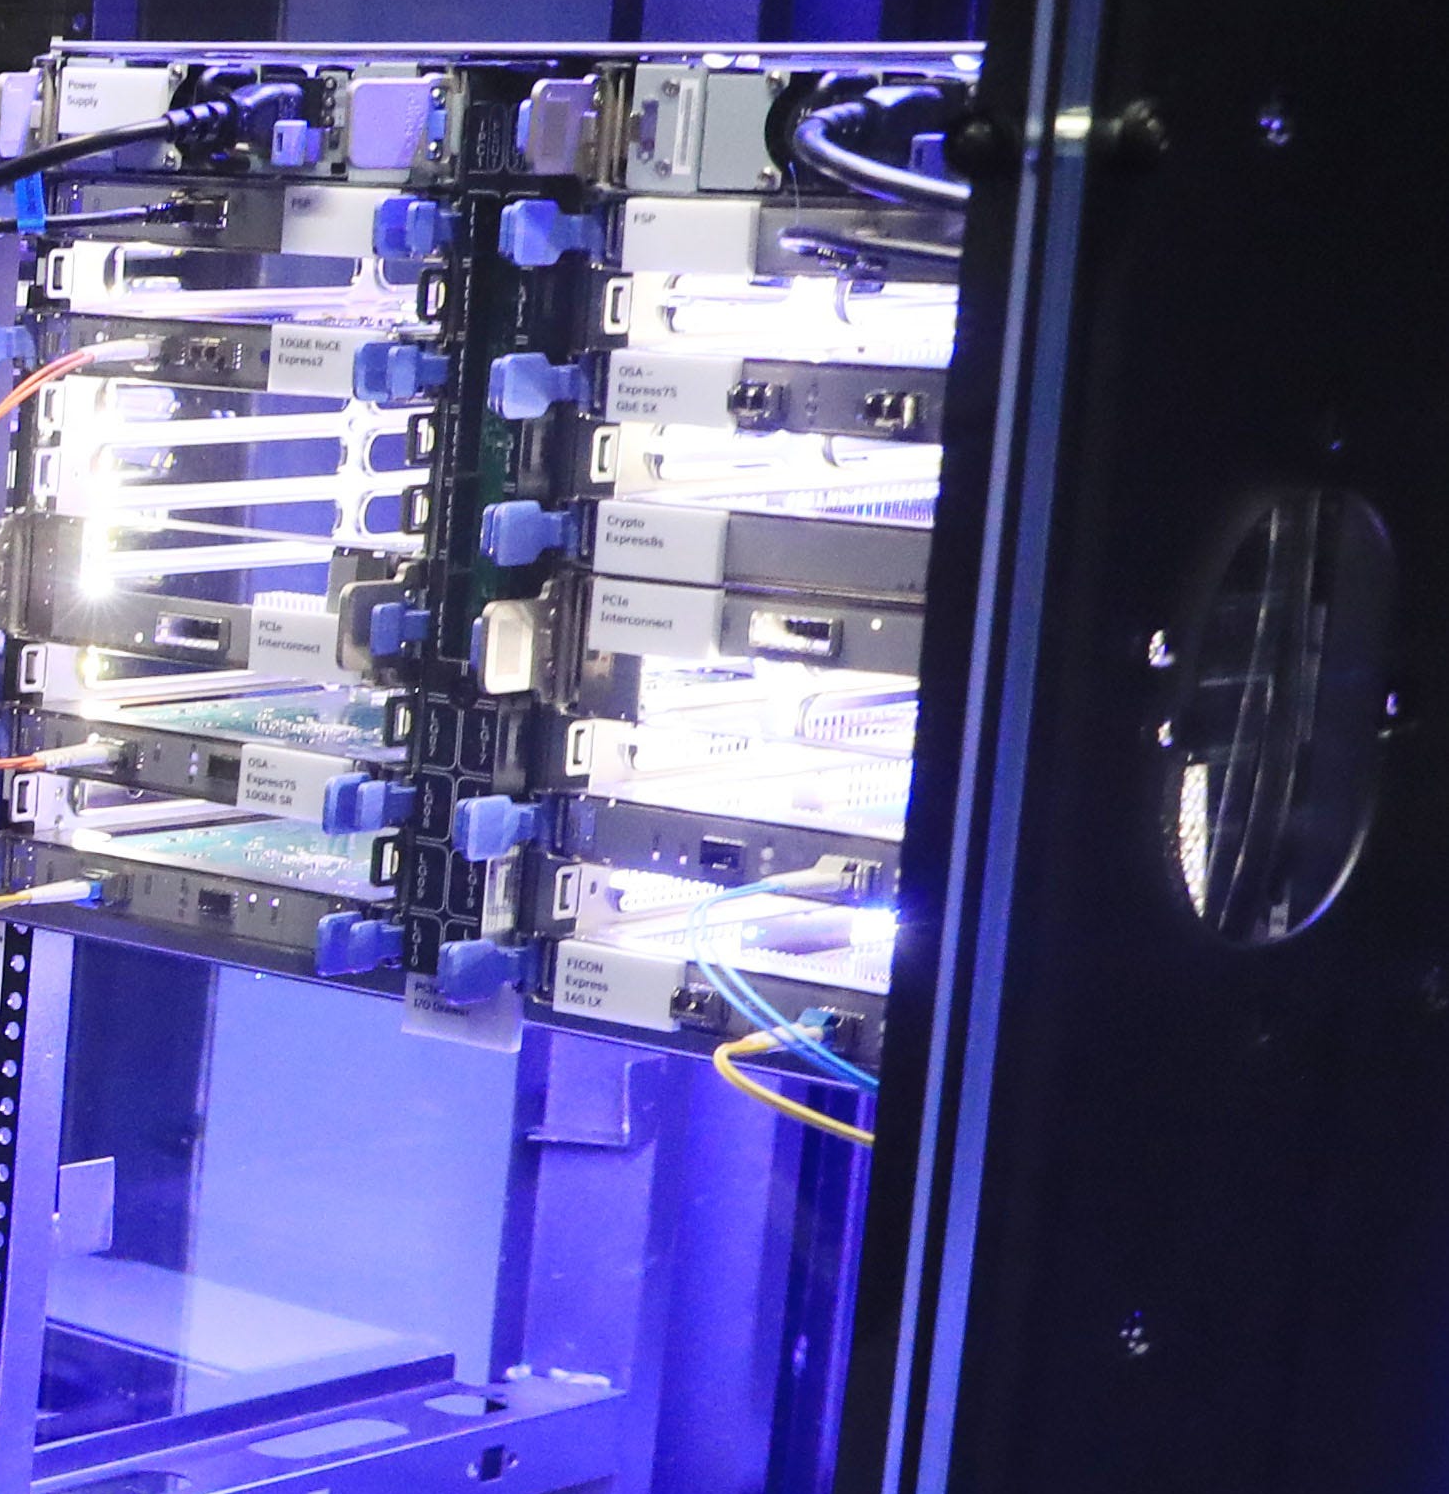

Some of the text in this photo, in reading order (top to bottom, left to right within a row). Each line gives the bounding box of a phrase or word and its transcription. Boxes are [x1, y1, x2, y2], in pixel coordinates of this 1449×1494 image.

[607, 515, 645, 528] Crypto
[601, 611, 672, 630] Interconnect
[258, 636, 320, 653] Interconnect
[567, 958, 603, 974] FICON
[566, 975, 608, 992] Express
